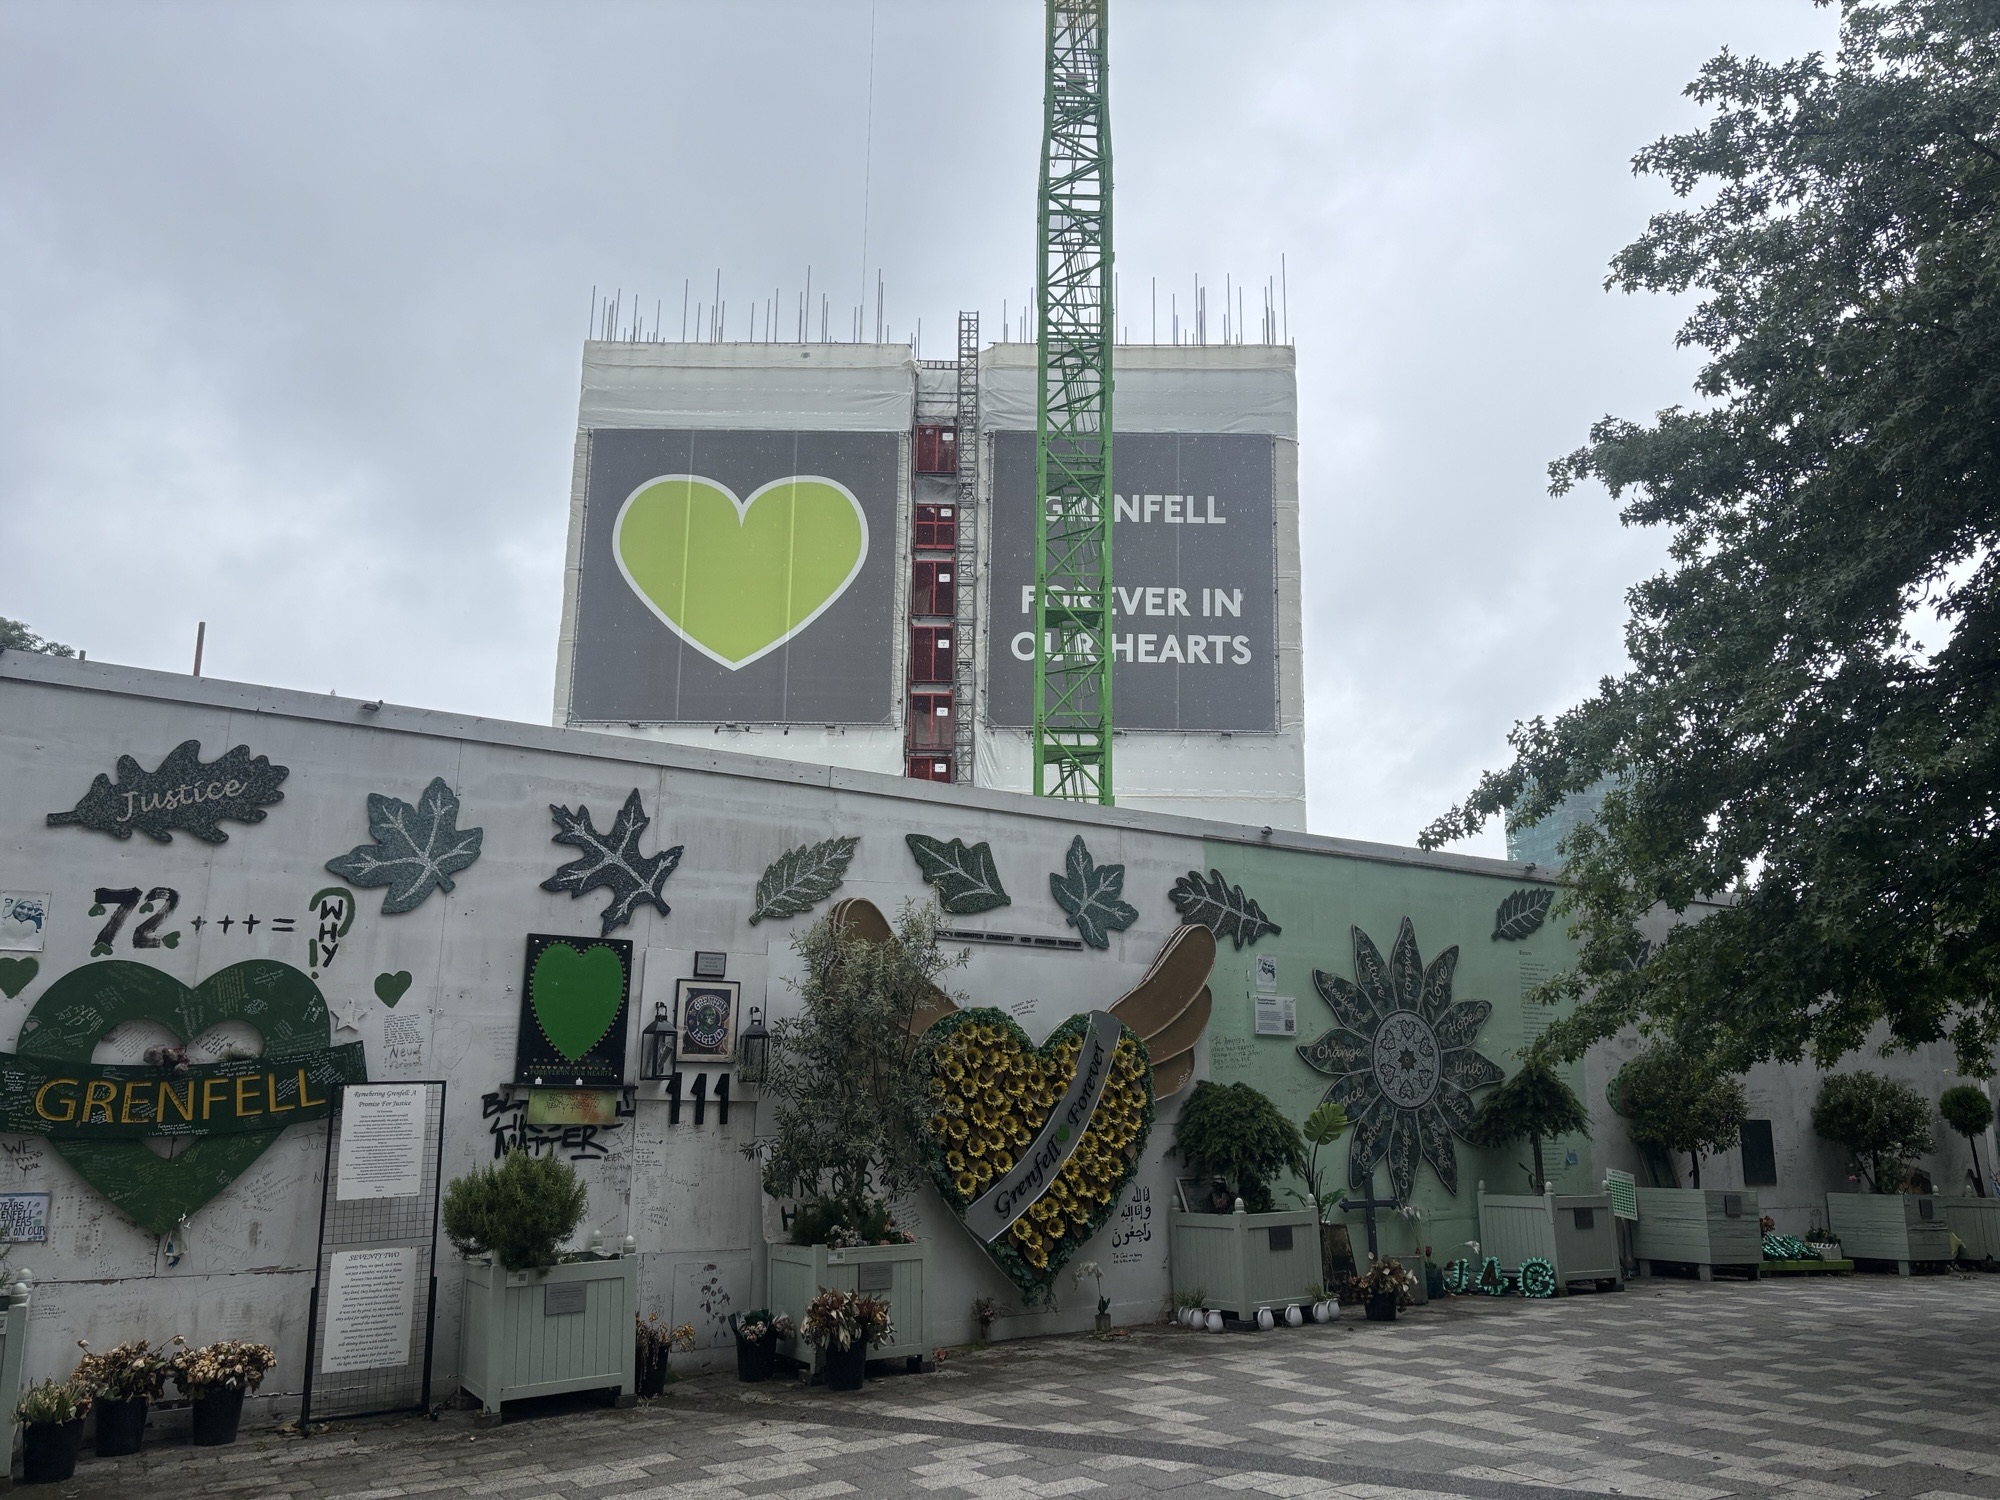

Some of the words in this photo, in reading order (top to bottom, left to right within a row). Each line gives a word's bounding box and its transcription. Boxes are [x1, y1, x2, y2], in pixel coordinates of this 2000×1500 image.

[1202, 588, 1242, 616] IN
[1011, 632, 1097, 662] OUR
[1112, 634, 1252, 664] HEARTS
[116, 777, 248, 822] Justice
[94, 886, 181, 949] 72
[1360, 948, 1385, 999] Future
[1403, 940, 1415, 1000] Forever
[1429, 965, 1448, 1006] Love
[694, 996, 726, 1014] GRENFELL
[692, 1028, 724, 1045] LEGEND
[1448, 1012, 1474, 1036] Hope
[1317, 1046, 1363, 1062] Change
[1454, 1061, 1488, 1078] Unity
[35, 1068, 327, 1123] GRENFELL
[994, 1134, 1066, 1220] Grenfell
[1066, 1038, 1107, 1127] Forever
[1356, 1113, 1385, 1166] Together
[1428, 1120, 1451, 1168] Respect
[2, 1138, 34, 1154] WE
[15, 1150, 43, 1165] miss
[1400, 1128, 1410, 1189] Courage
[1, 1210, 35, 1219] ENFELL
[13, 1227, 25, 1236] ON
[28, 1226, 45, 1236] OUR
[349, 1253, 383, 1261] SEVENTY
